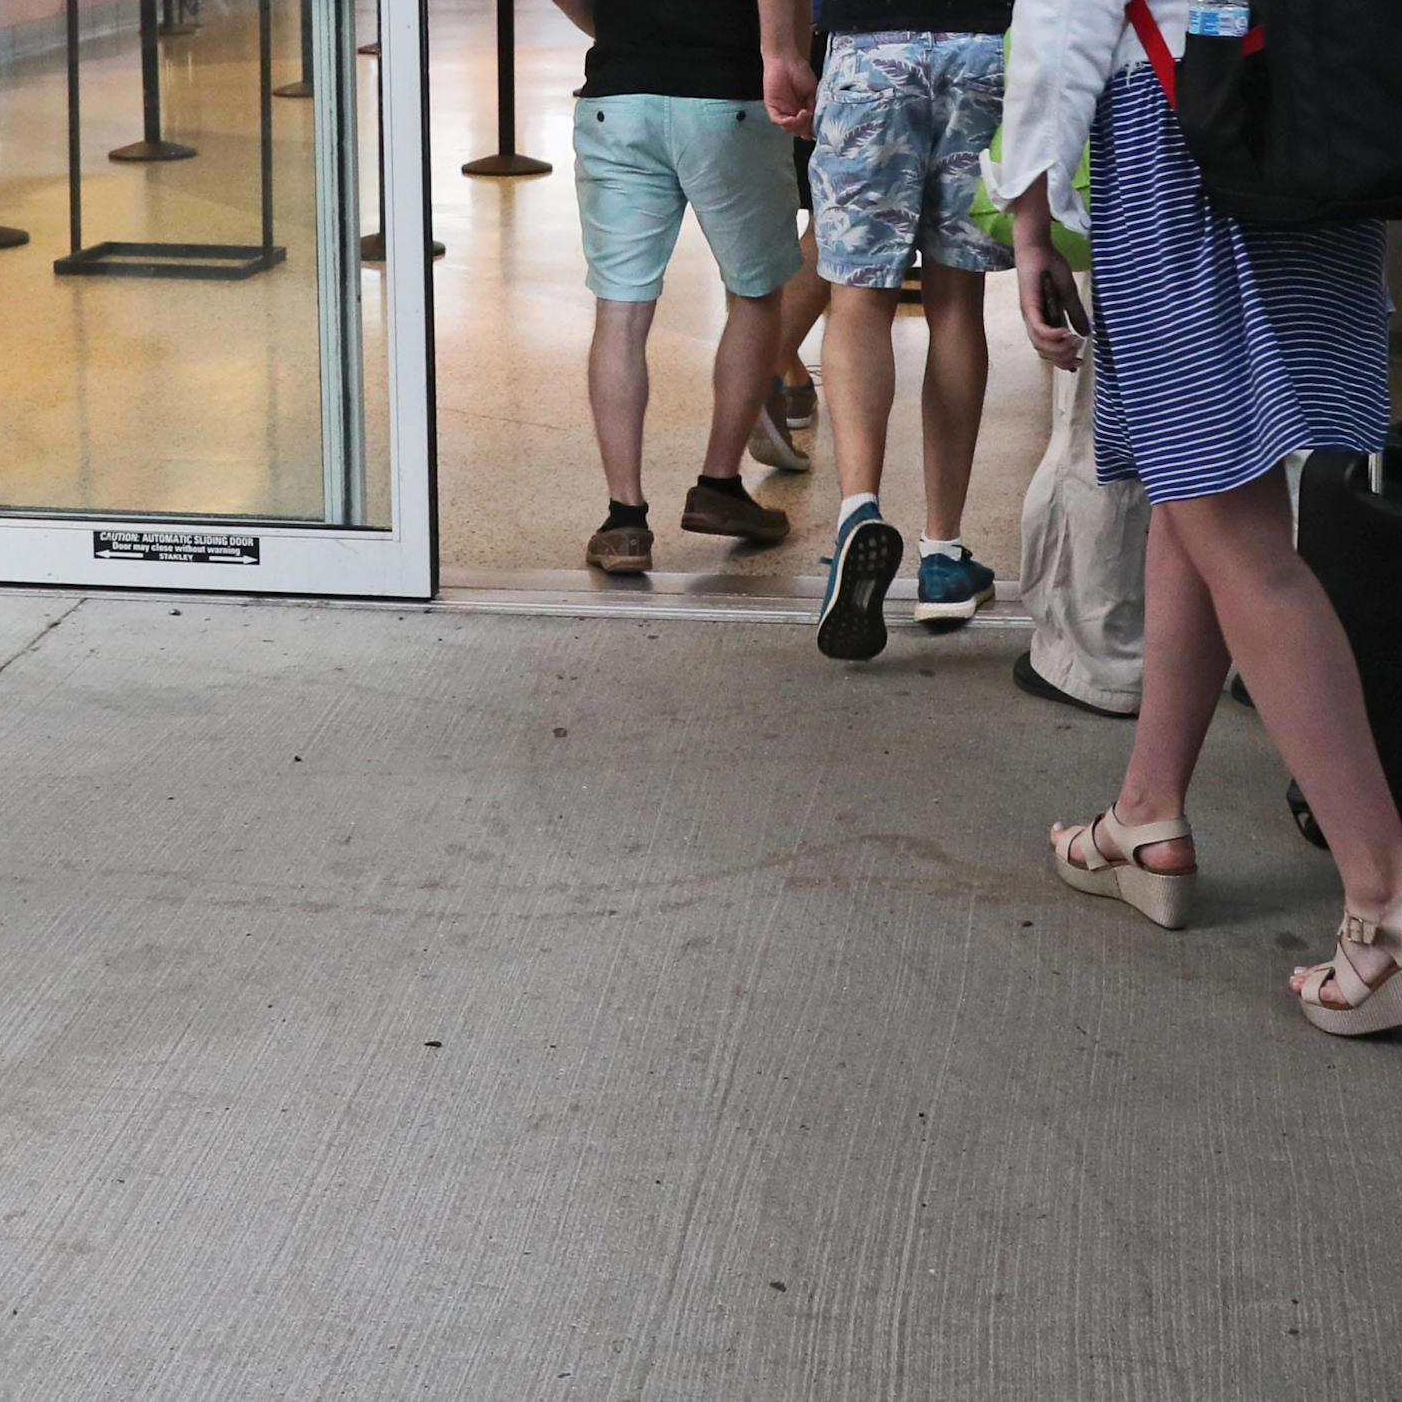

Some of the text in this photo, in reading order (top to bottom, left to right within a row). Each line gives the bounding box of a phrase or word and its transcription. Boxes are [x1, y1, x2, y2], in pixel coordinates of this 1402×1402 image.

[100, 532, 254, 547] CAUTION: AUTOMATIC SLIDING DOOR
[112, 542, 240, 556] Door may close without warning
[159, 553, 194, 561] STANLEY
